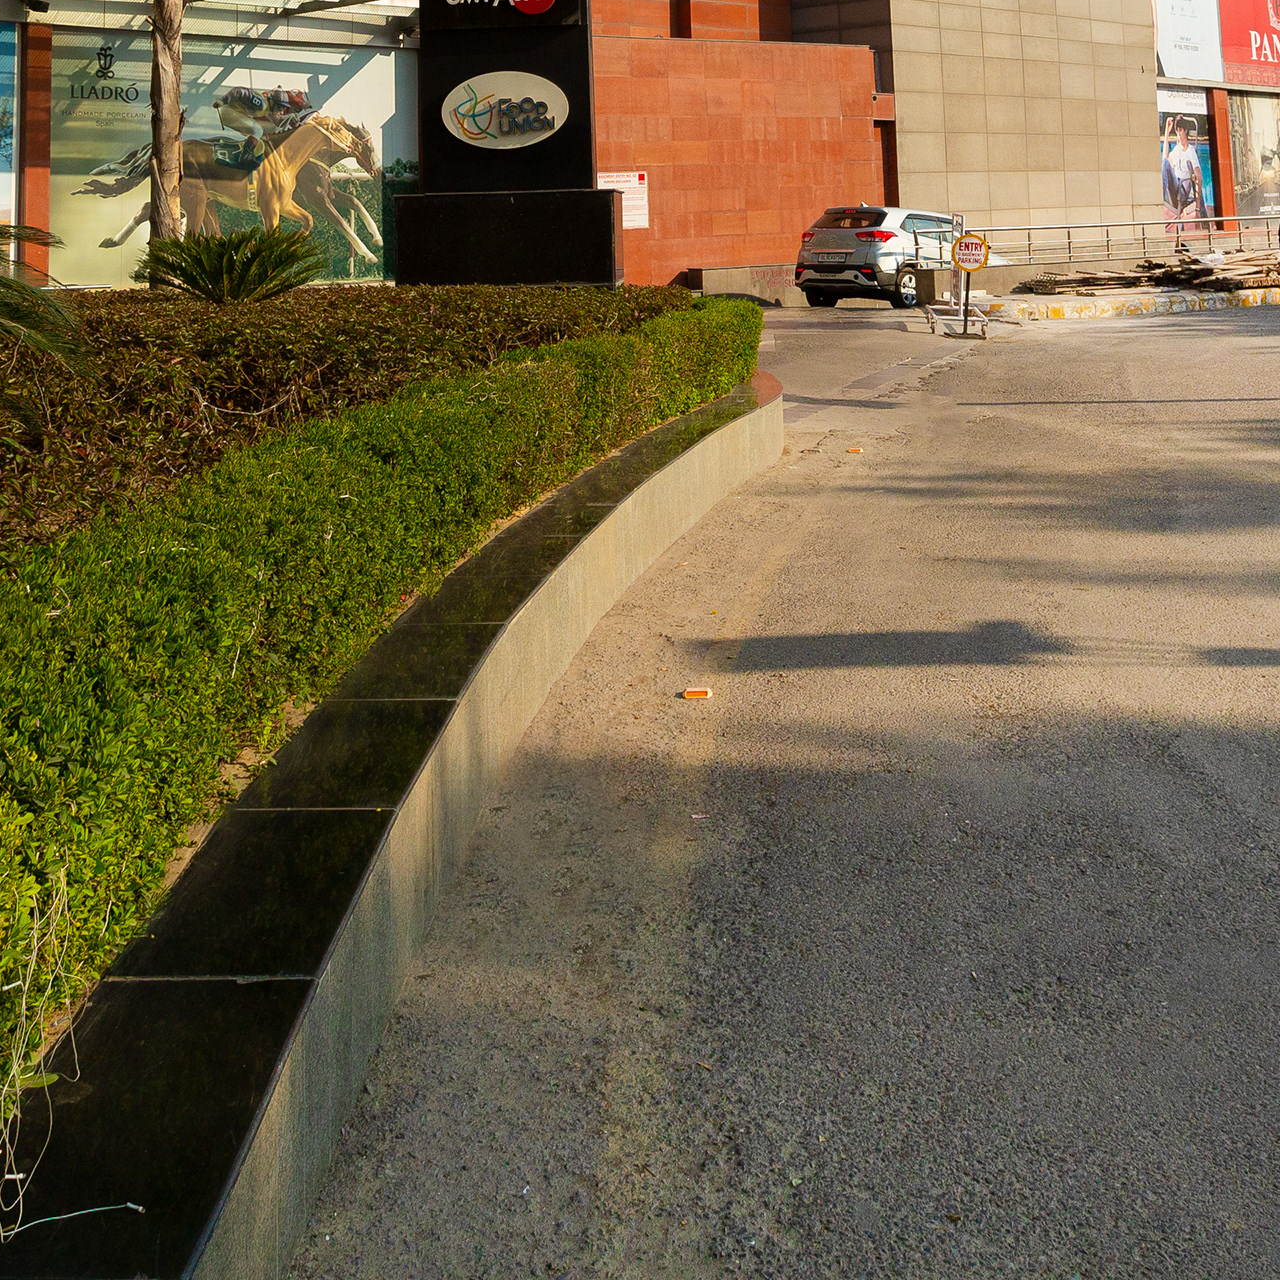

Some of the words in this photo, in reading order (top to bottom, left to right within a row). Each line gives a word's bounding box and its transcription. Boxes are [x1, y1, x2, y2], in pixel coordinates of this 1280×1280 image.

[70, 82, 139, 104] LLADRÓ
[61, 109, 104, 118] HANDMADE
[106, 111, 147, 119] PORCELAIN
[498, 96, 549, 119] FOOD
[95, 120, 115, 128] Spain
[499, 115, 557, 135] UNION
[958, 241, 983, 252] ENTRY
